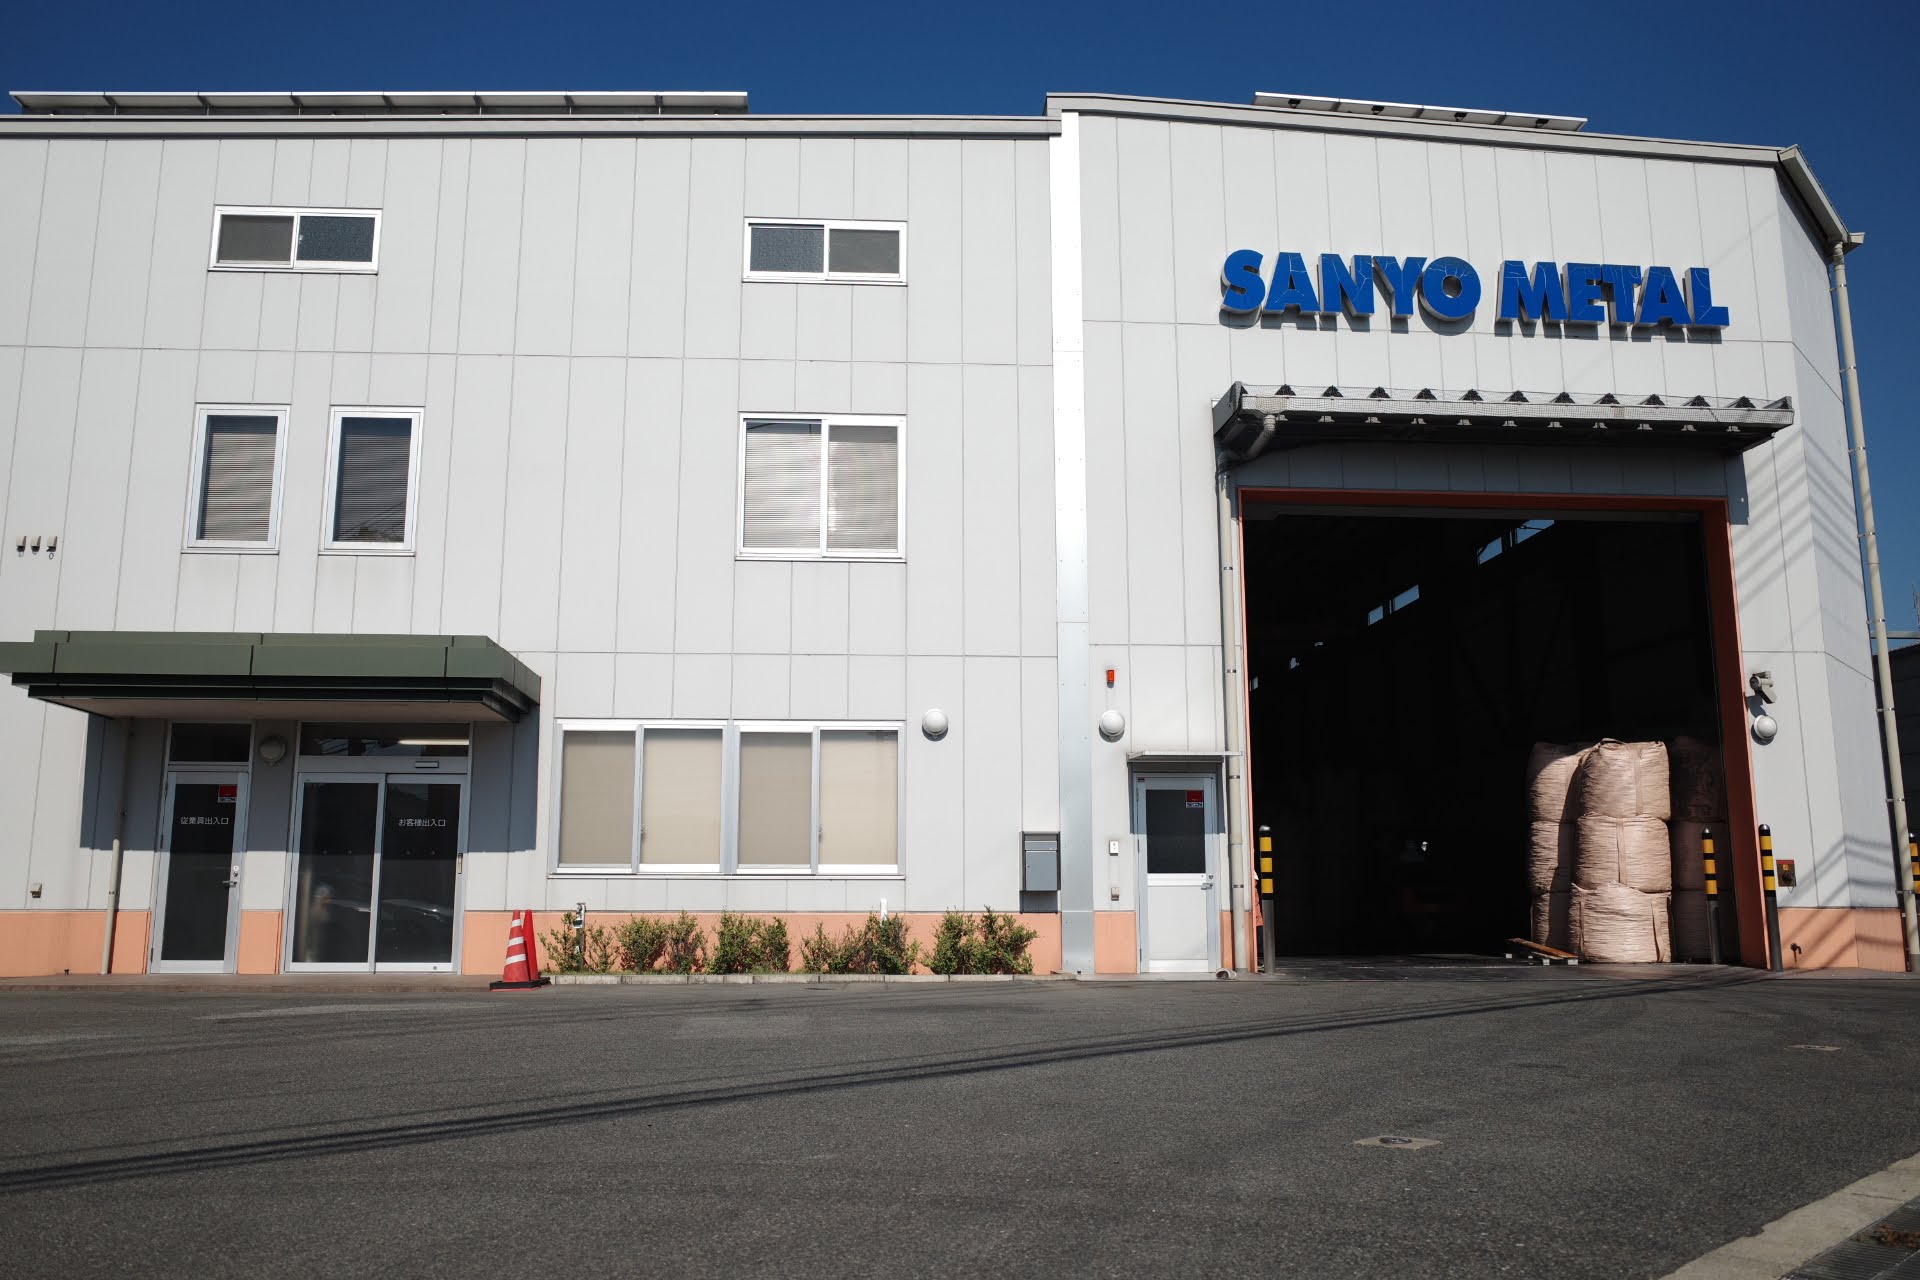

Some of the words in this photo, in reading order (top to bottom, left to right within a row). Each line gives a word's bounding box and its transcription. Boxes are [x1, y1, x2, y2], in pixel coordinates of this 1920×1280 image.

[1220, 248, 1482, 322] SANYO
[1497, 260, 1730, 330] METAL
[180, 816, 229, 825] 従業員出入口
[398, 818, 446, 827] お客様出入口
